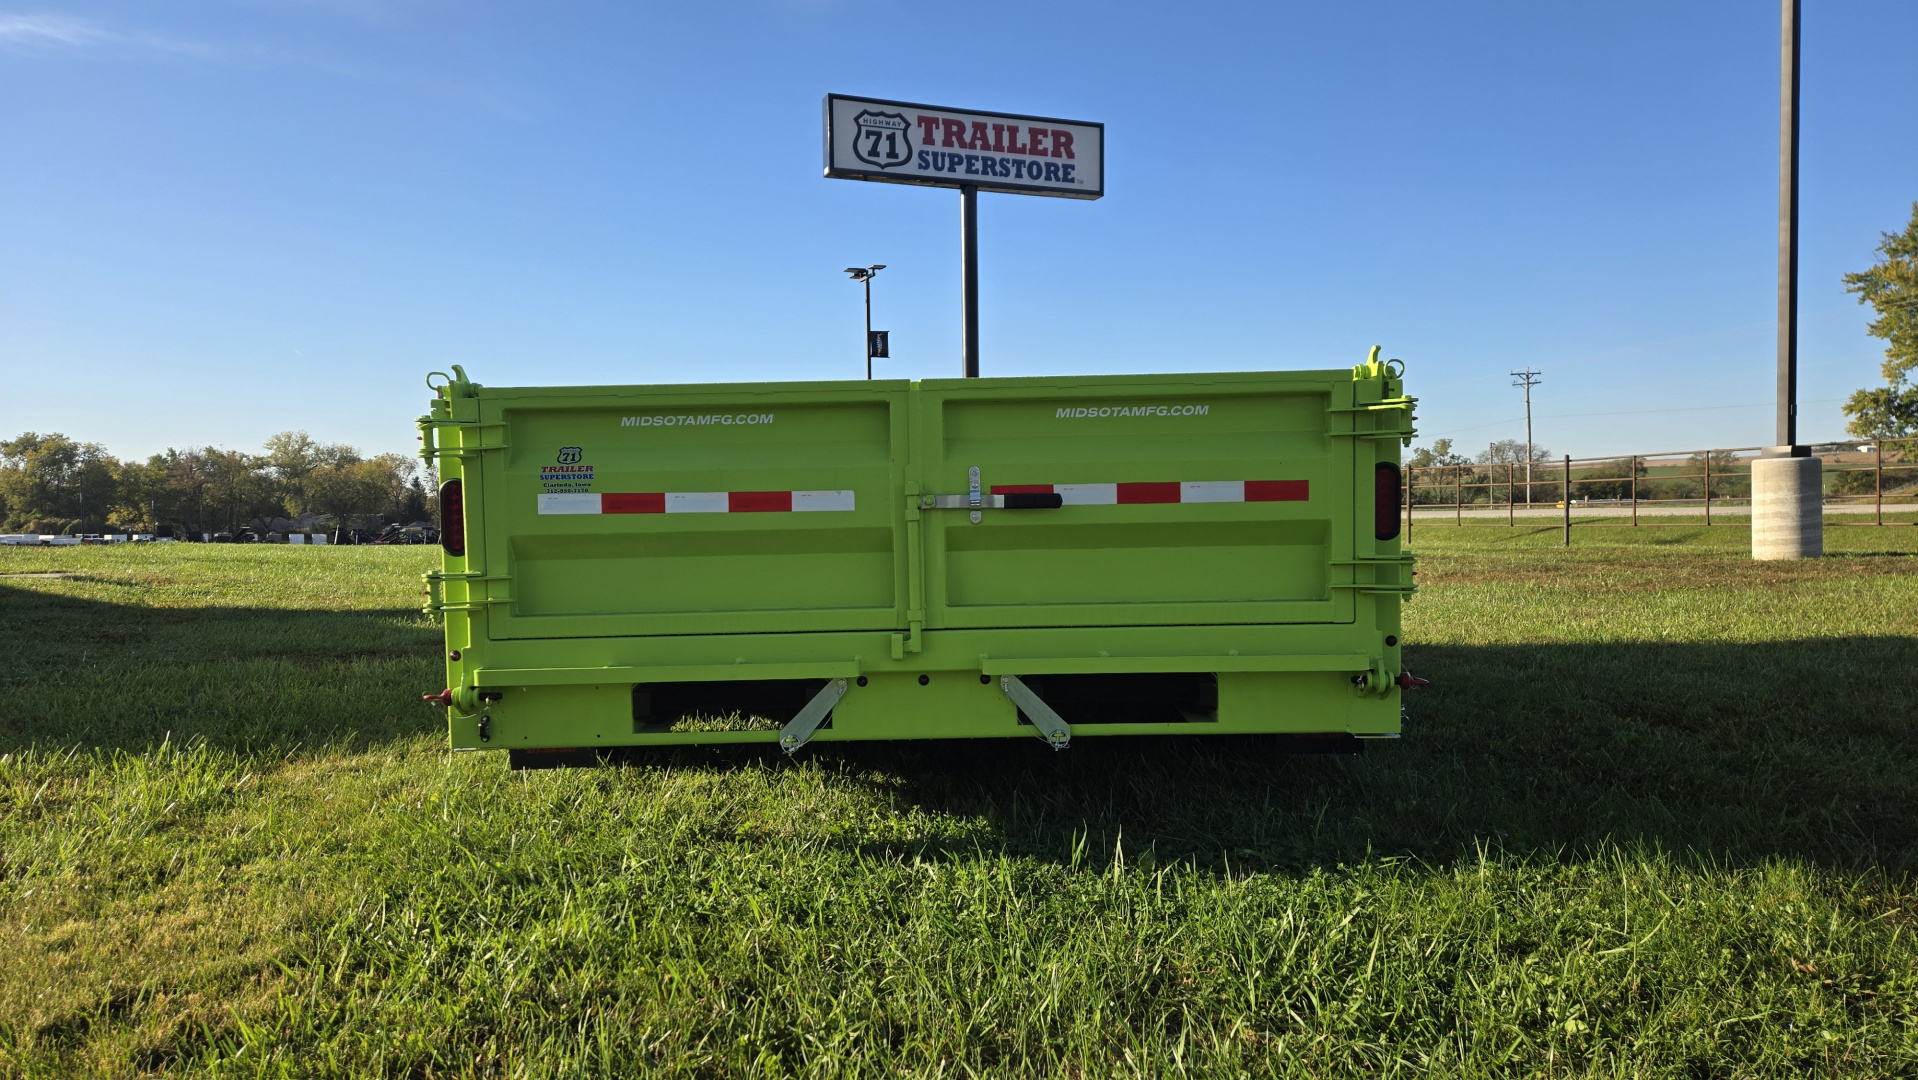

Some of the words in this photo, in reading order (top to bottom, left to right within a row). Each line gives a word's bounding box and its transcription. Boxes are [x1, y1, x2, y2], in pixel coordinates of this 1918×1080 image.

[863, 118, 902, 127] HIGHWAY
[917, 115, 1076, 159] TRAILER
[865, 130, 899, 159] 71
[917, 150, 1076, 184] SUPERSTORE
[1056, 405, 1209, 418] MIDSOTAMFG.COM
[621, 413, 774, 427] MIDSOTAMFG.COM
[562, 453, 576, 461] 71
